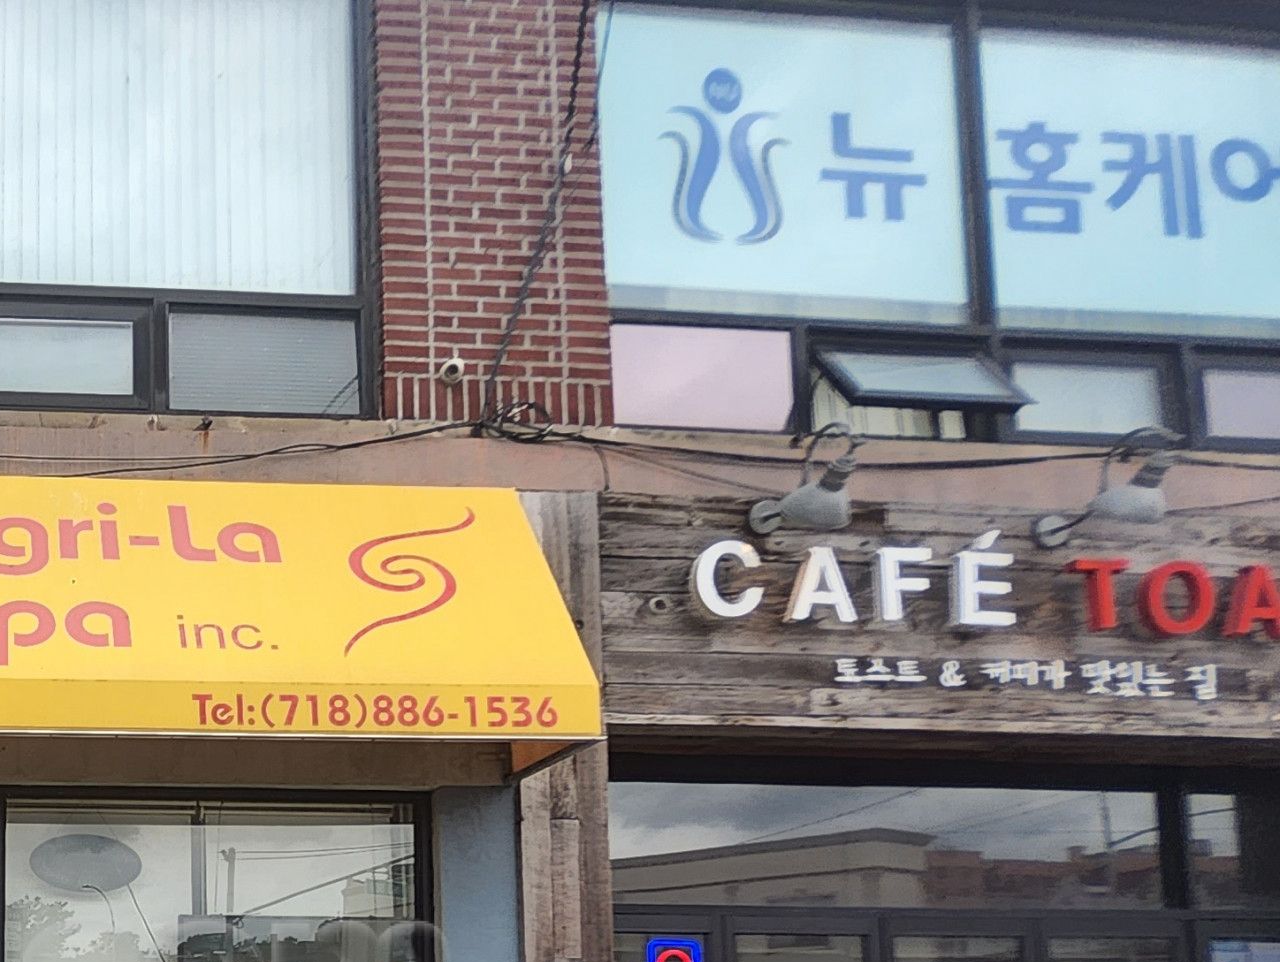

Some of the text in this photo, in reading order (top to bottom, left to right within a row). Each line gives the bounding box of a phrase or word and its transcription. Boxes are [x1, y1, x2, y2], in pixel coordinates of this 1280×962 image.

[690, 529, 1018, 627] CAFÉ
[176, 614, 279, 650] inc.
[833, 657, 927, 684] 토스트
[939, 659, 967, 687] &
[193, 693, 560, 730] Tel:(718)886-1536
